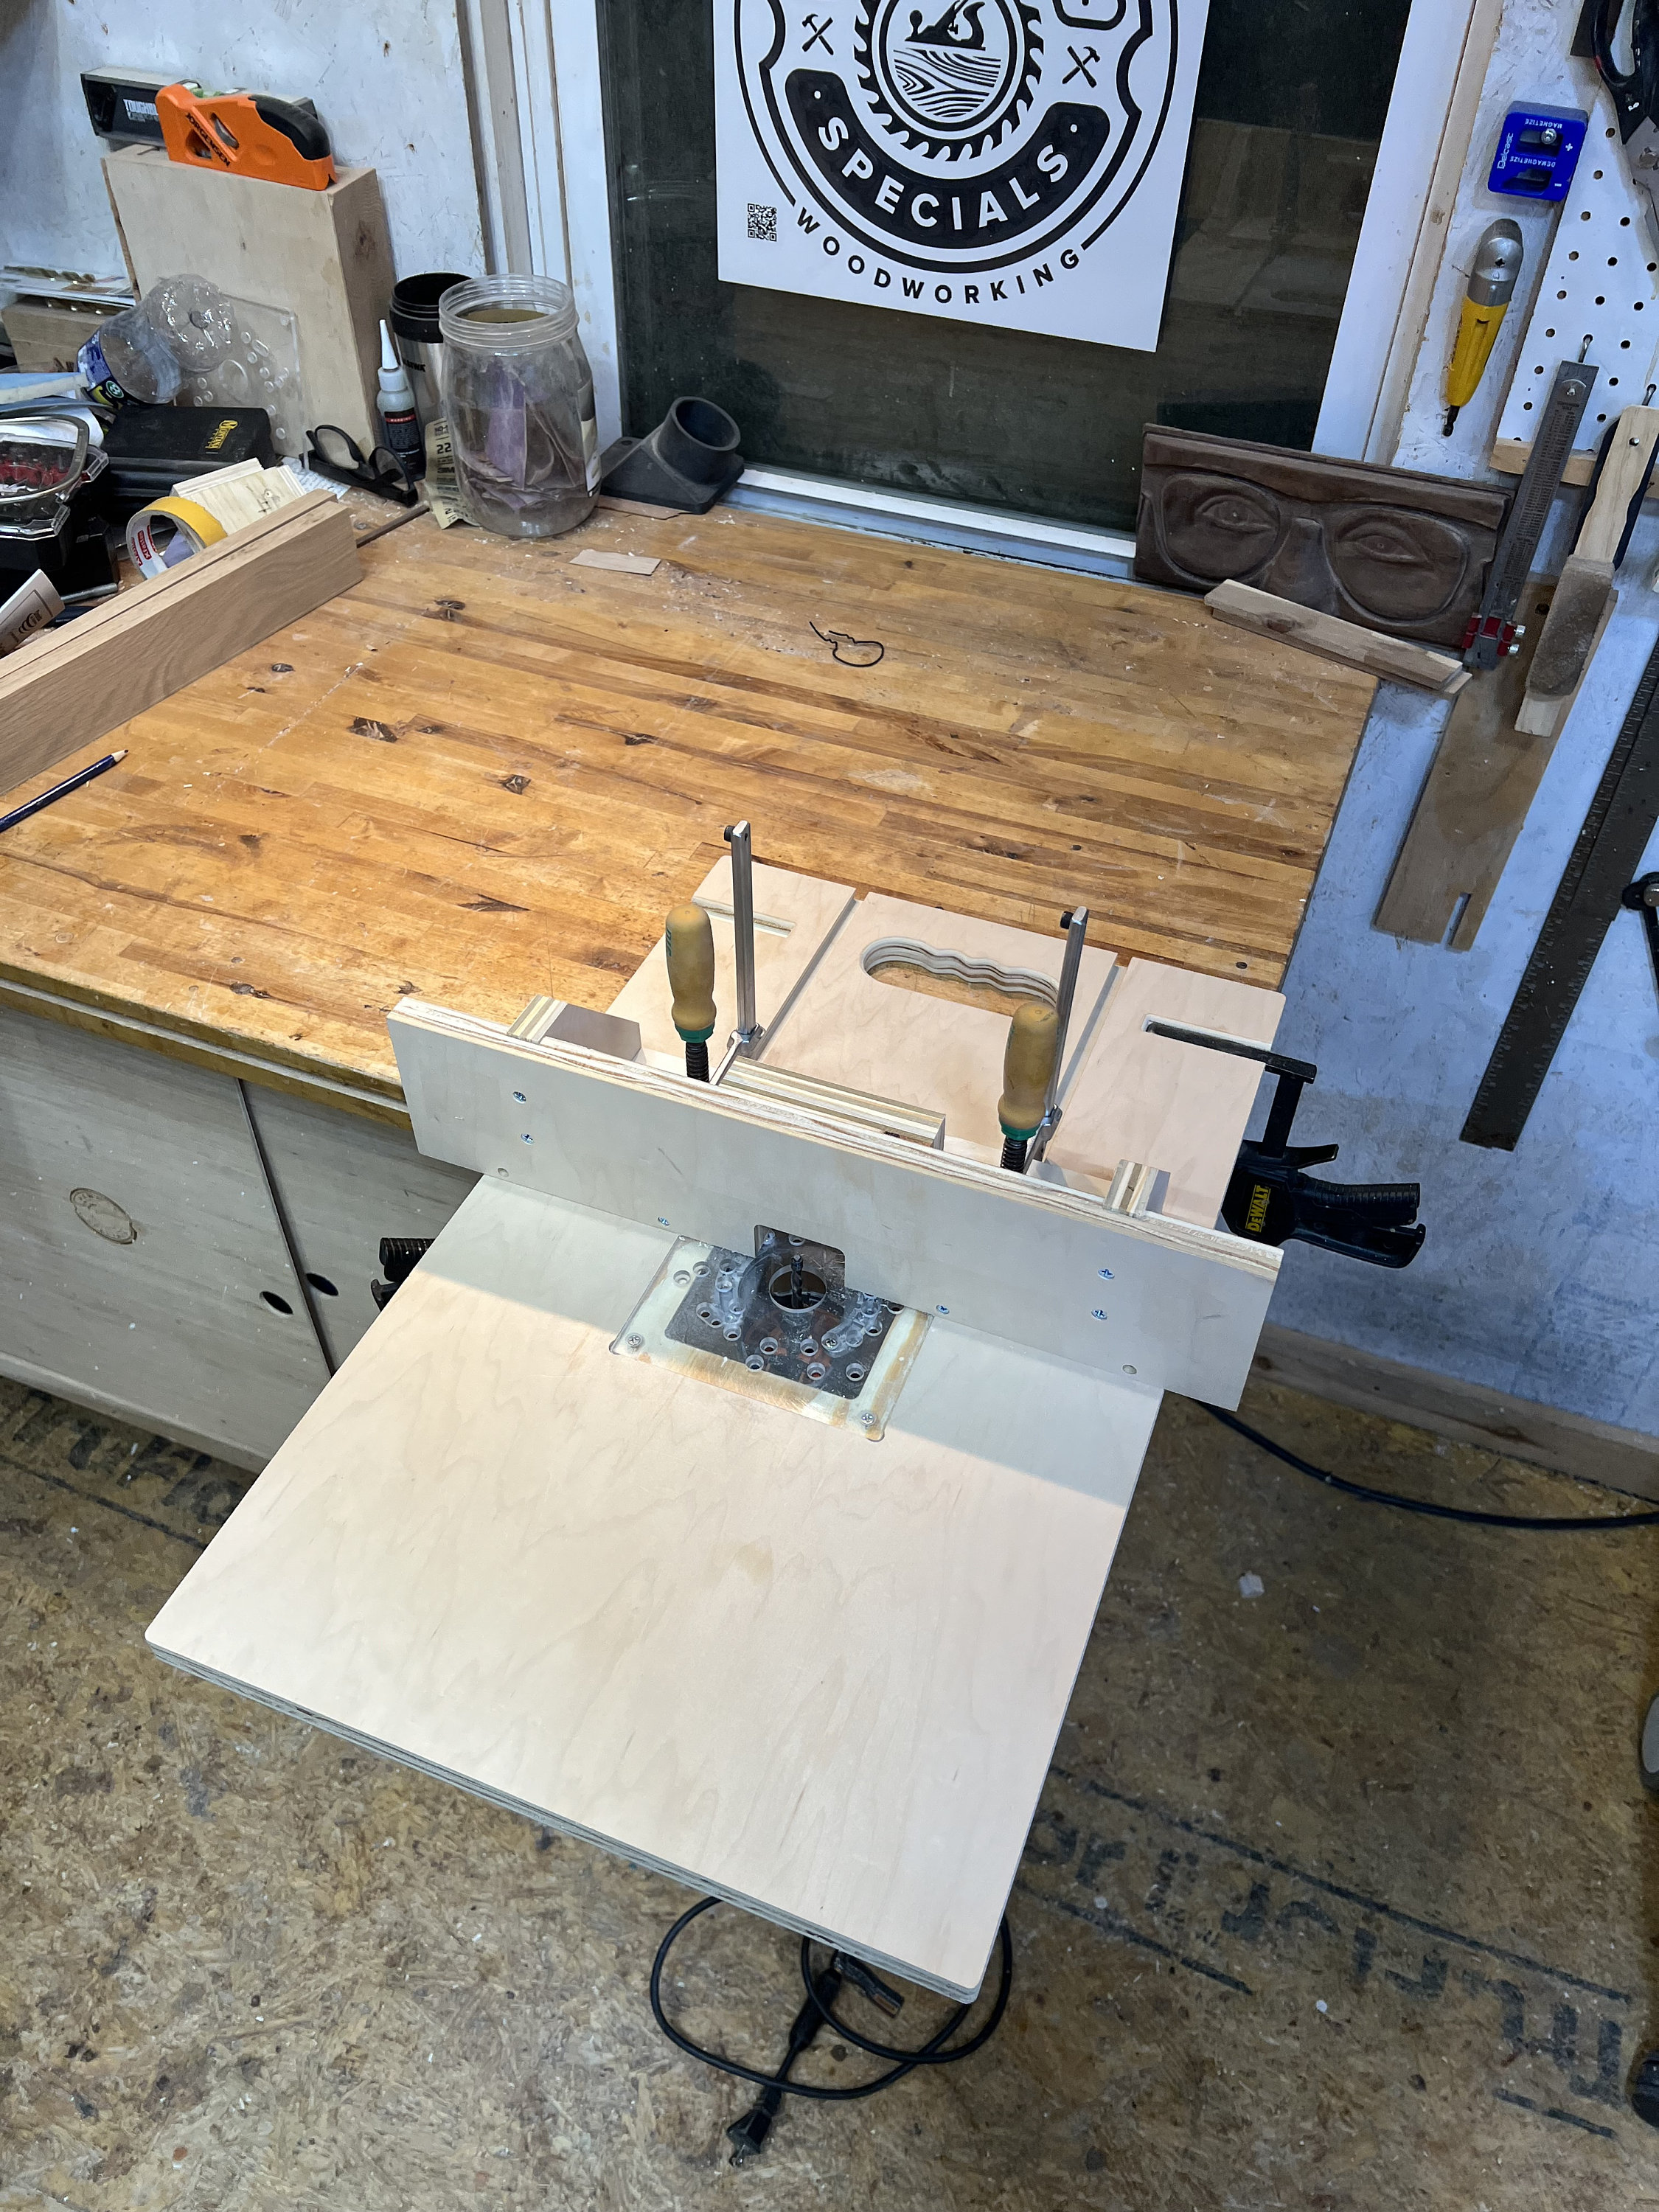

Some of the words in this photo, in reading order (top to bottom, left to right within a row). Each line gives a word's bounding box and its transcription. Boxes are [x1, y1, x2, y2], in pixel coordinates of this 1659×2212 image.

[1525, 118, 1562, 129] MAGNETIZE
[818, 116, 1068, 231] SPECIALS
[1510, 156, 1556, 168] DEMAGNETIZE
[797, 207, 1079, 305] WOODWORKING
